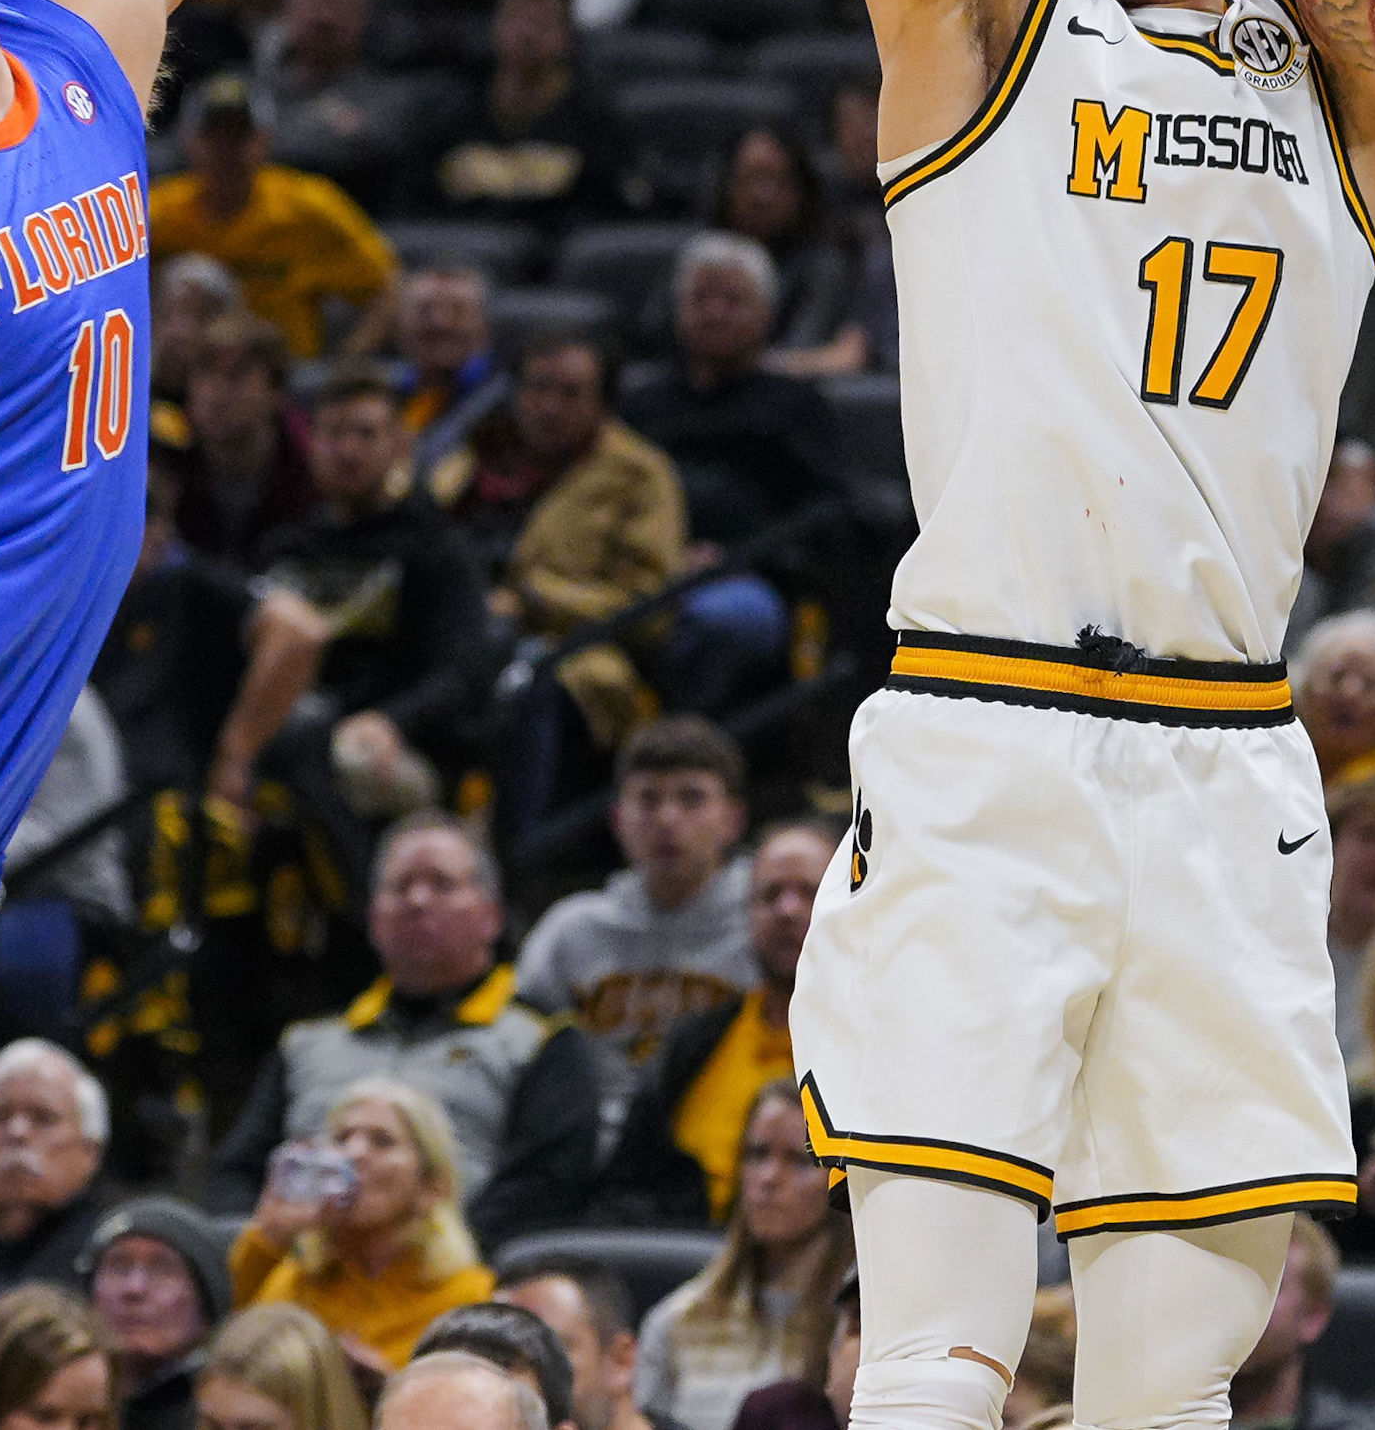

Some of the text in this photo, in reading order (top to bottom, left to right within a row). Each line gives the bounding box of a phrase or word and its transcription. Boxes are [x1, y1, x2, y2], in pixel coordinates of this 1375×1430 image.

[1234, 19, 1288, 71] SEC
[1244, 58, 1304, 89] GRADUATE
[66, 85, 94, 120] SEC
[1138, 236, 1285, 410] 17
[61, 308, 134, 471] 10
